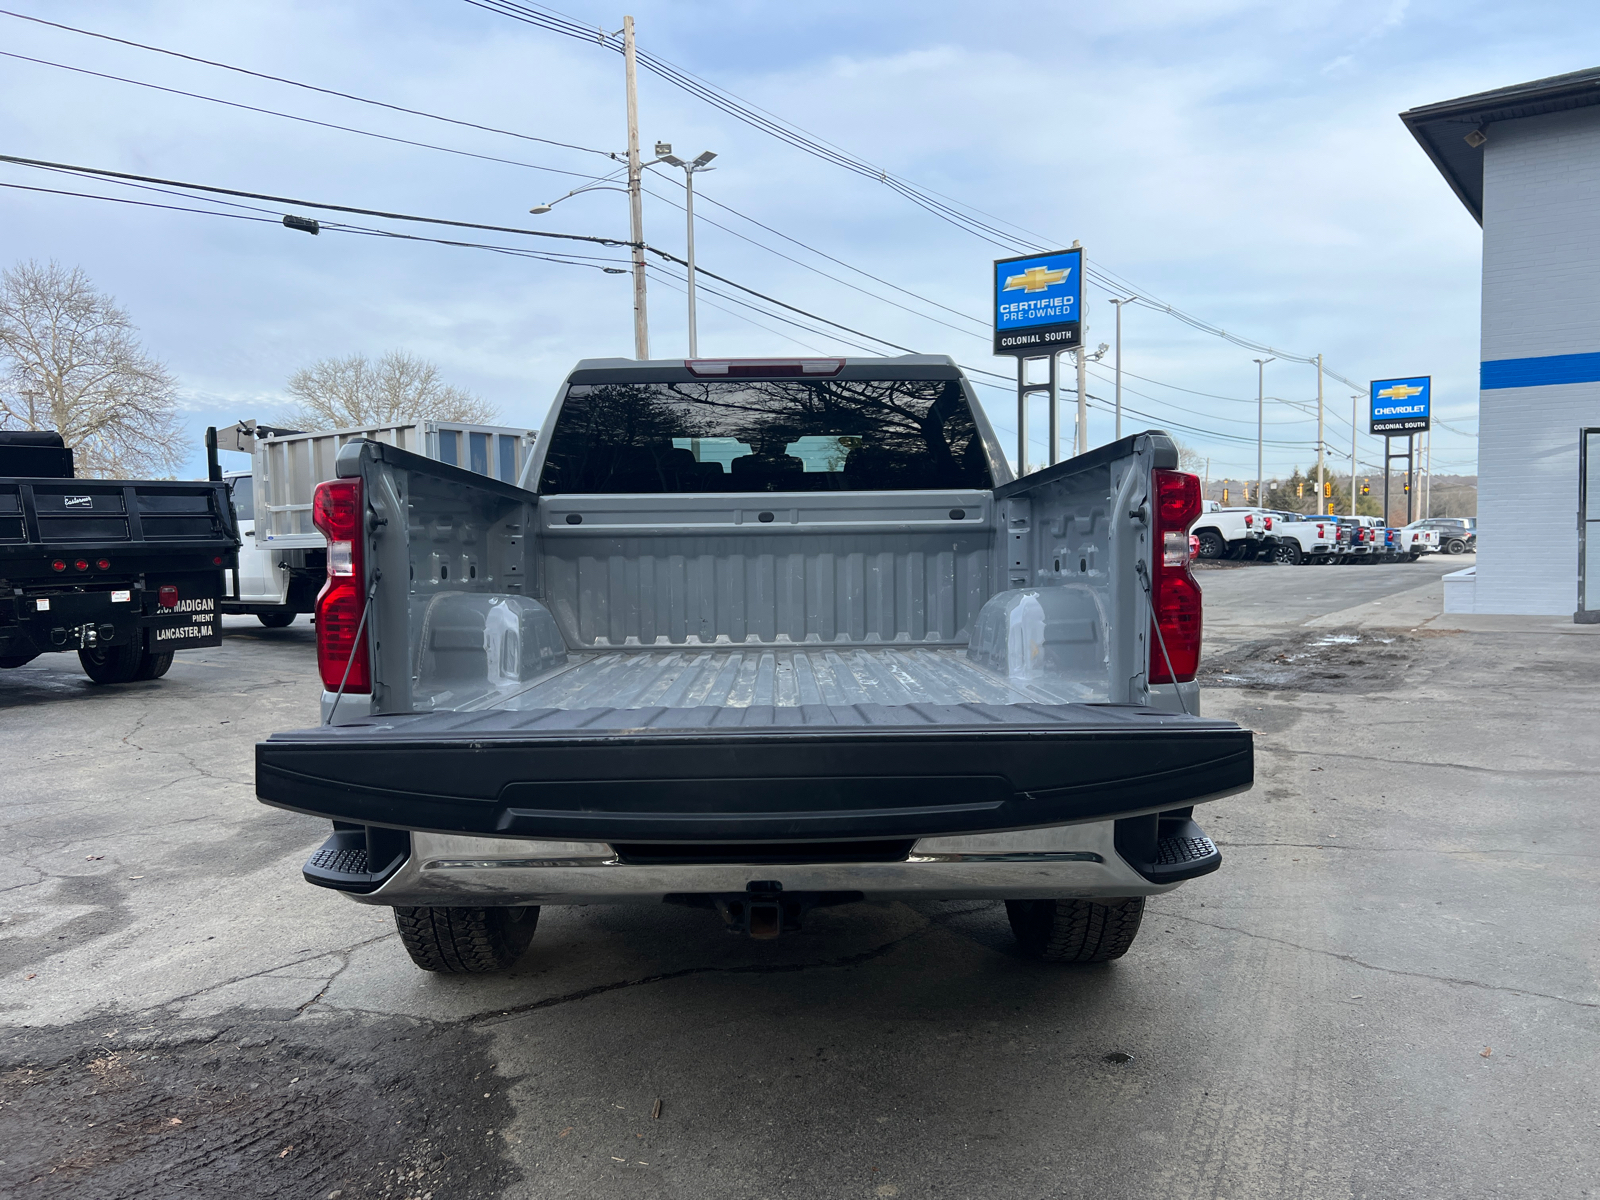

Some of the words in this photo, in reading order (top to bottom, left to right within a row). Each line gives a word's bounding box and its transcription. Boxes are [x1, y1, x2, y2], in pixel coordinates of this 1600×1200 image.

[1000, 296, 1074, 313] CERTIFIED
[1003, 306, 1070, 321] PRE-OWNED
[1002, 334, 1040, 346] COLONIAL
[1045, 331, 1072, 341] SOUTH
[1374, 405, 1425, 415] CHEVROLET
[173, 598, 214, 612] MADIGAN
